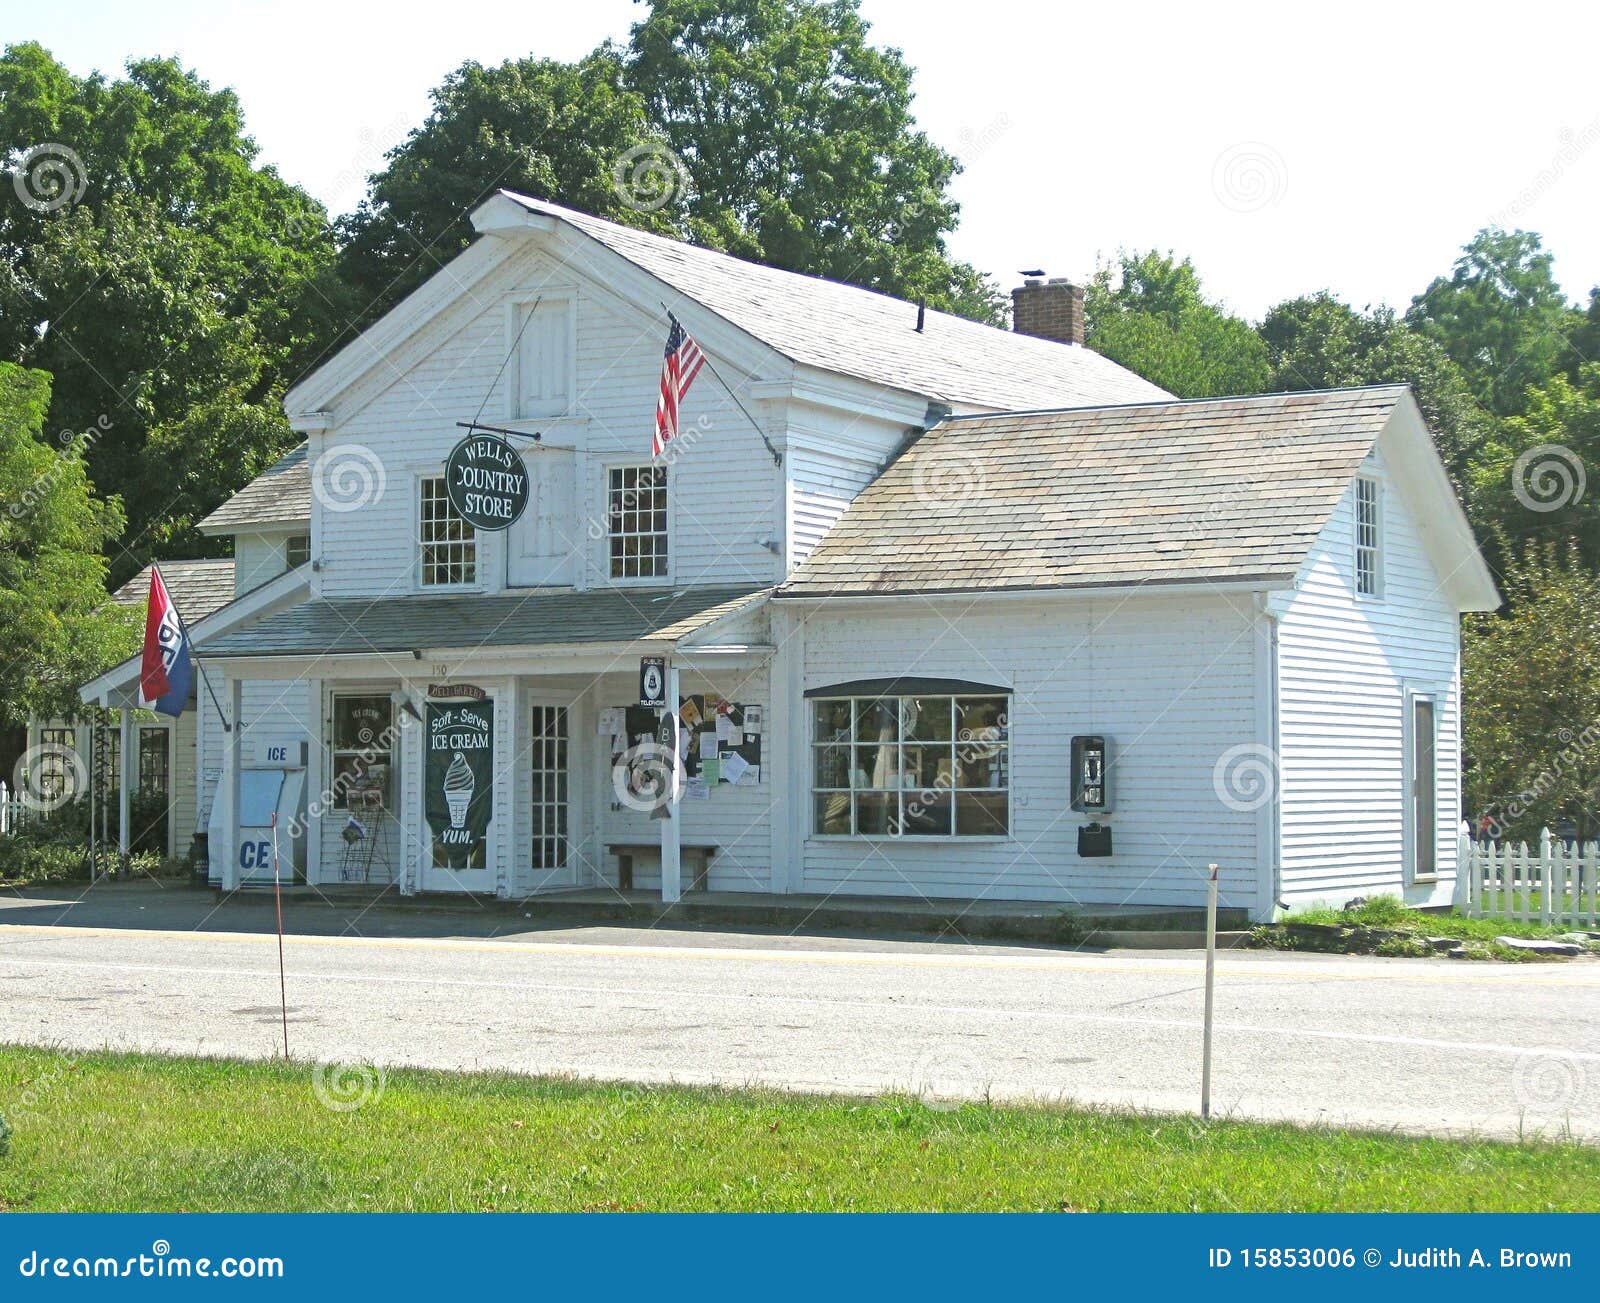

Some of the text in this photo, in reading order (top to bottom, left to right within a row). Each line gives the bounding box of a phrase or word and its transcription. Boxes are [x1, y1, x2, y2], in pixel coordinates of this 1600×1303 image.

[465, 441, 513, 468] WELLS
[465, 493, 513, 519] STORE
[431, 710, 452, 733] Soft
[461, 708, 489, 731] Serve
[267, 747, 287, 761] ICE
[431, 733, 489, 750] ICE CREAM
[442, 829, 473, 844] YUM.
[239, 841, 272, 869] CE
